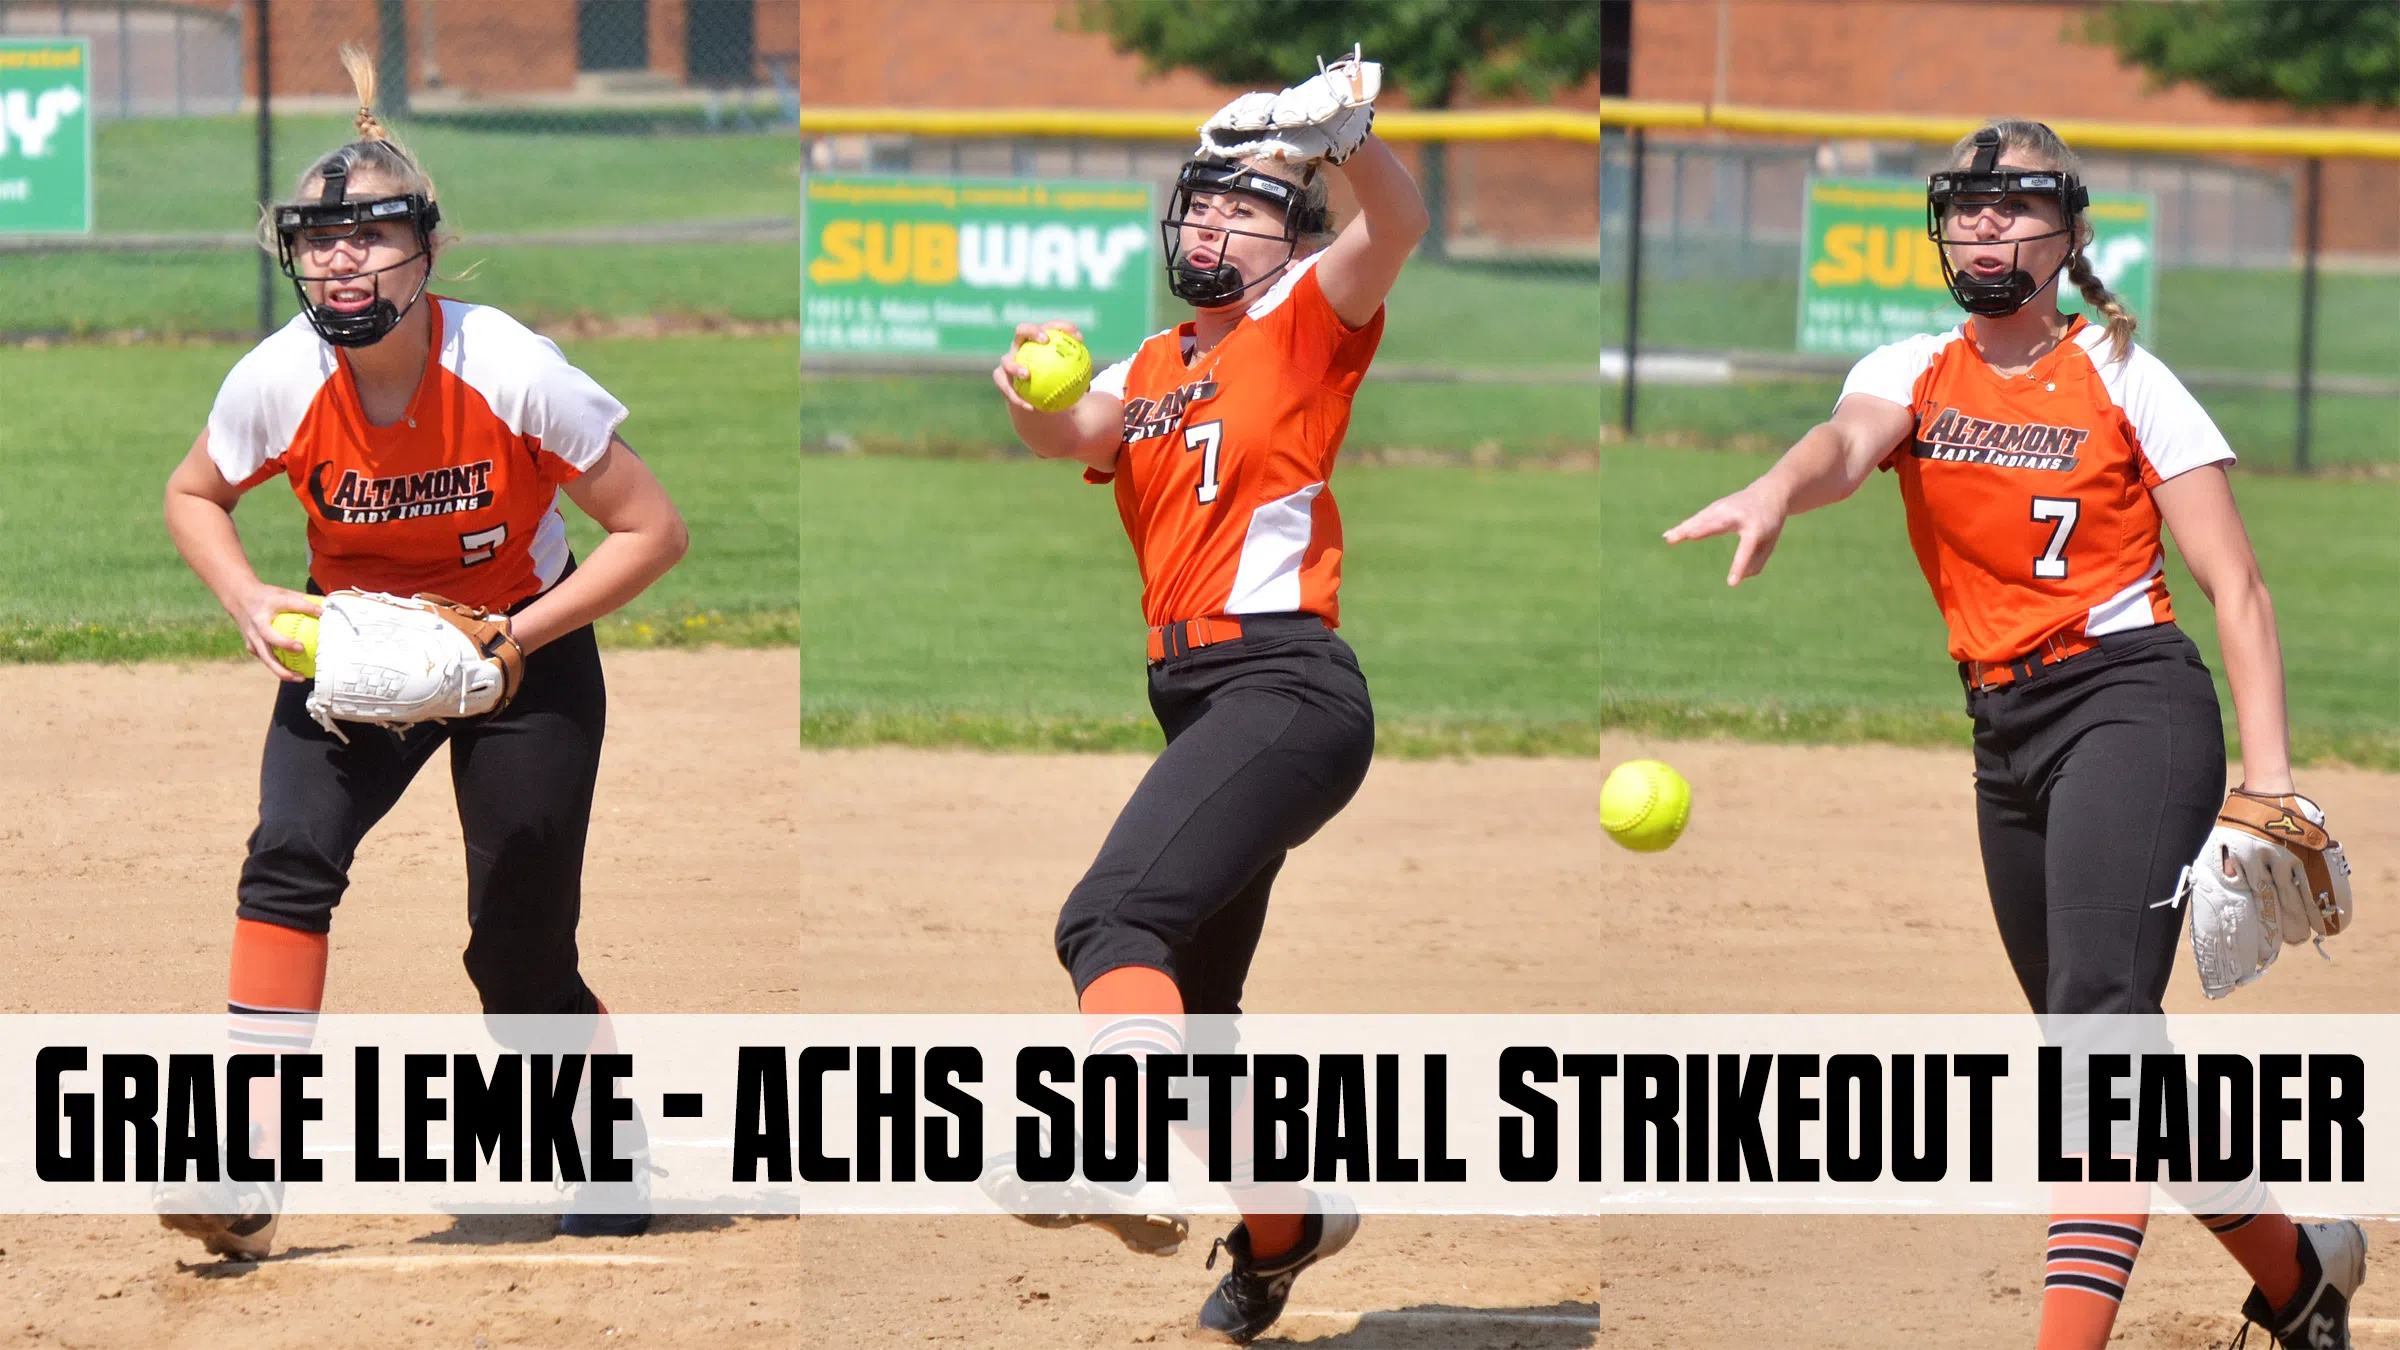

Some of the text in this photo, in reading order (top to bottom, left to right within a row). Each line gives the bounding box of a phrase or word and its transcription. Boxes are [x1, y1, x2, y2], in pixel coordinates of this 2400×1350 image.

[808, 219, 1147, 291] SUBWAY
[1184, 418, 1223, 505] 7
[2030, 495, 2081, 580] 7
